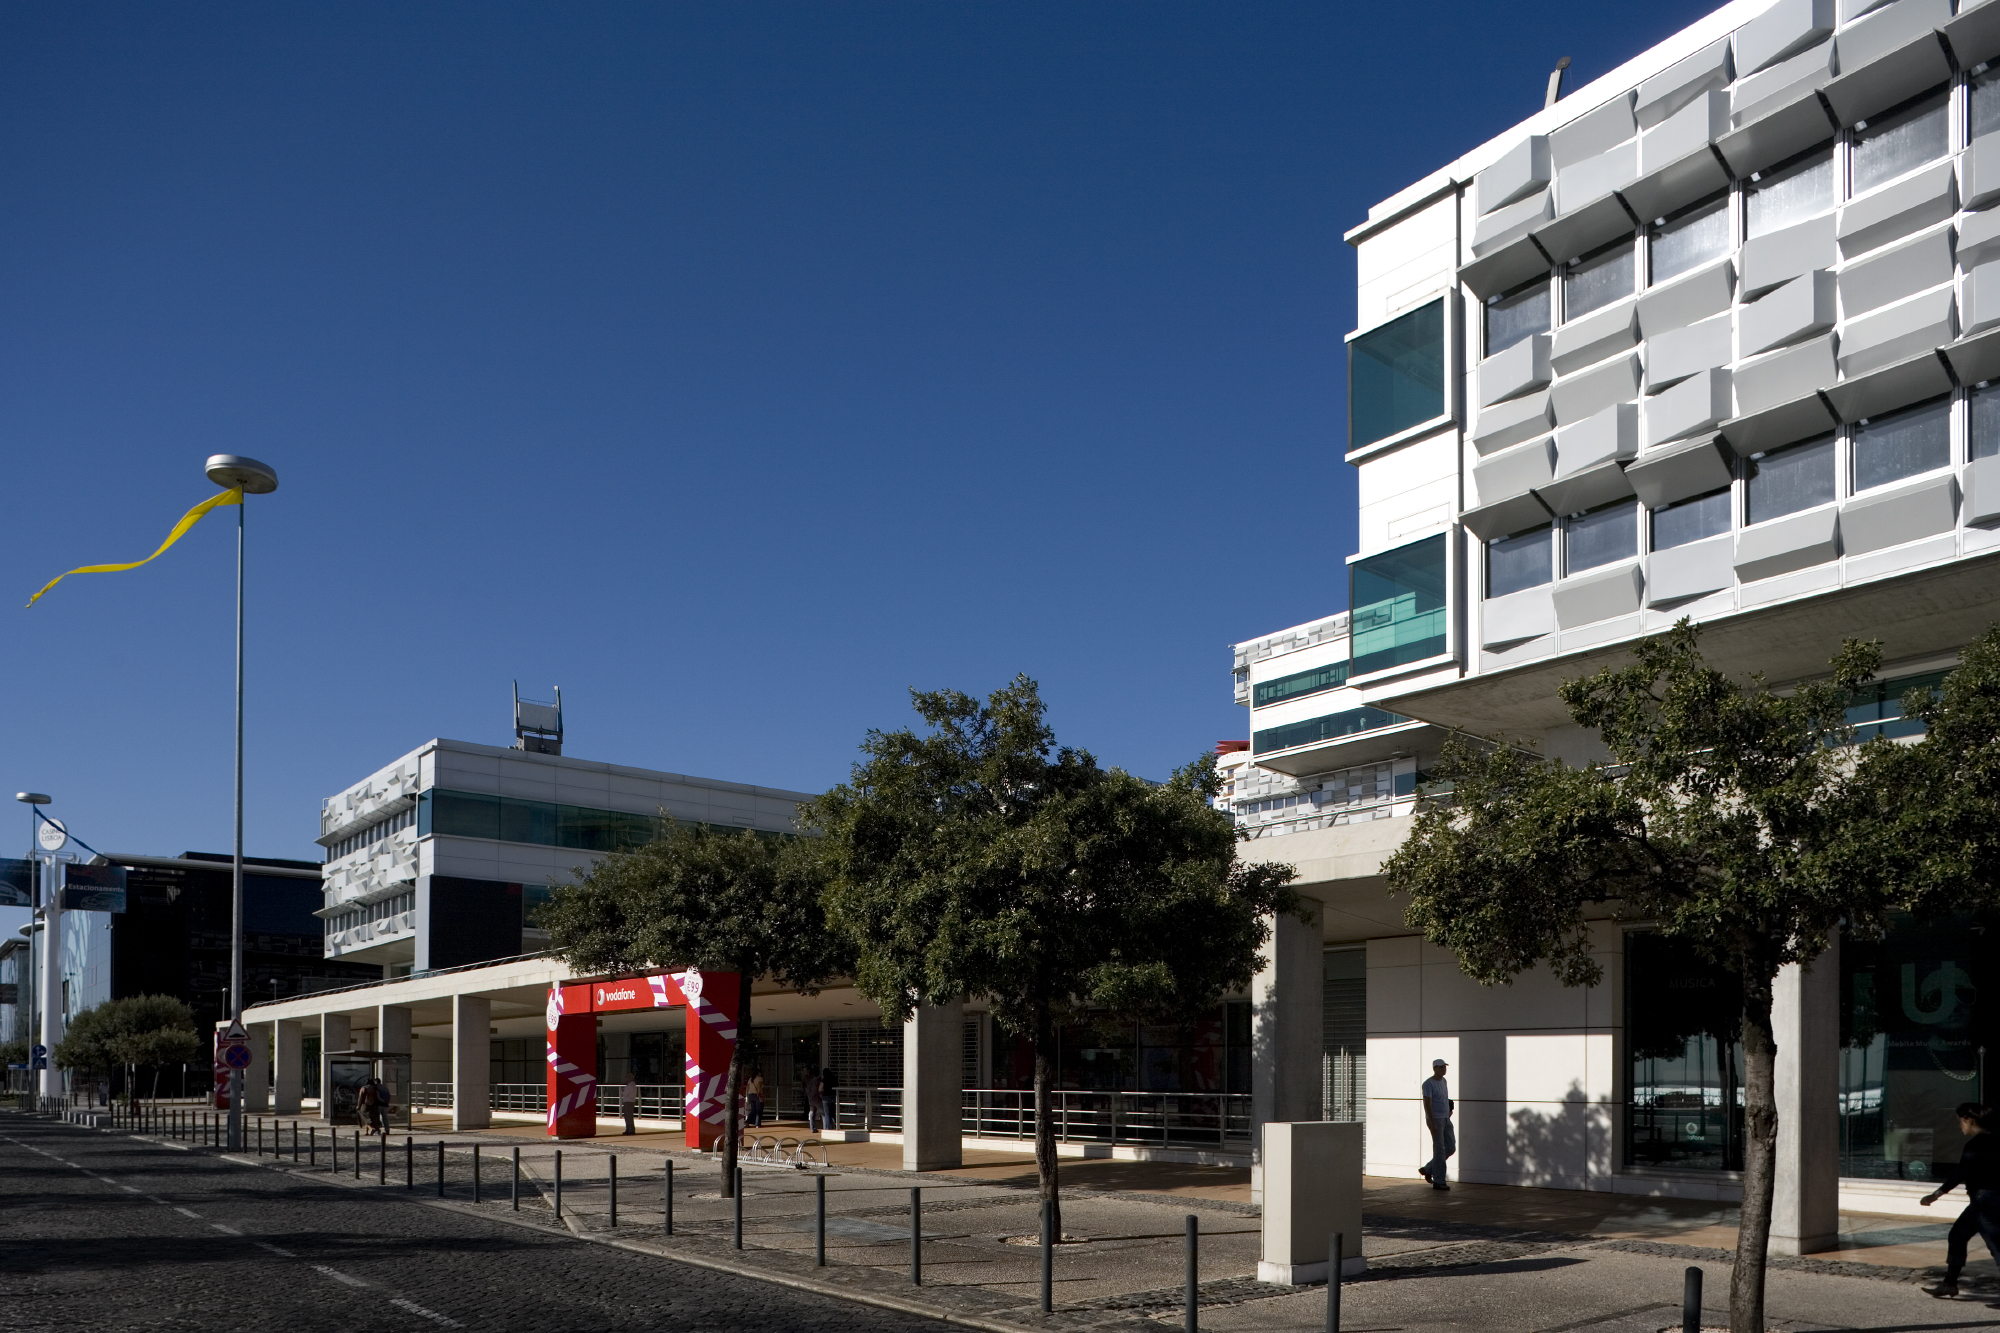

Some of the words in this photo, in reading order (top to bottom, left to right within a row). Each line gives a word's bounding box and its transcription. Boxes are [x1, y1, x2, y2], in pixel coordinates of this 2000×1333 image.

[68, 883, 125, 893] Estacionamento
[606, 988, 636, 1001] vodafone
[1941, 1039, 1972, 1047] Awards
